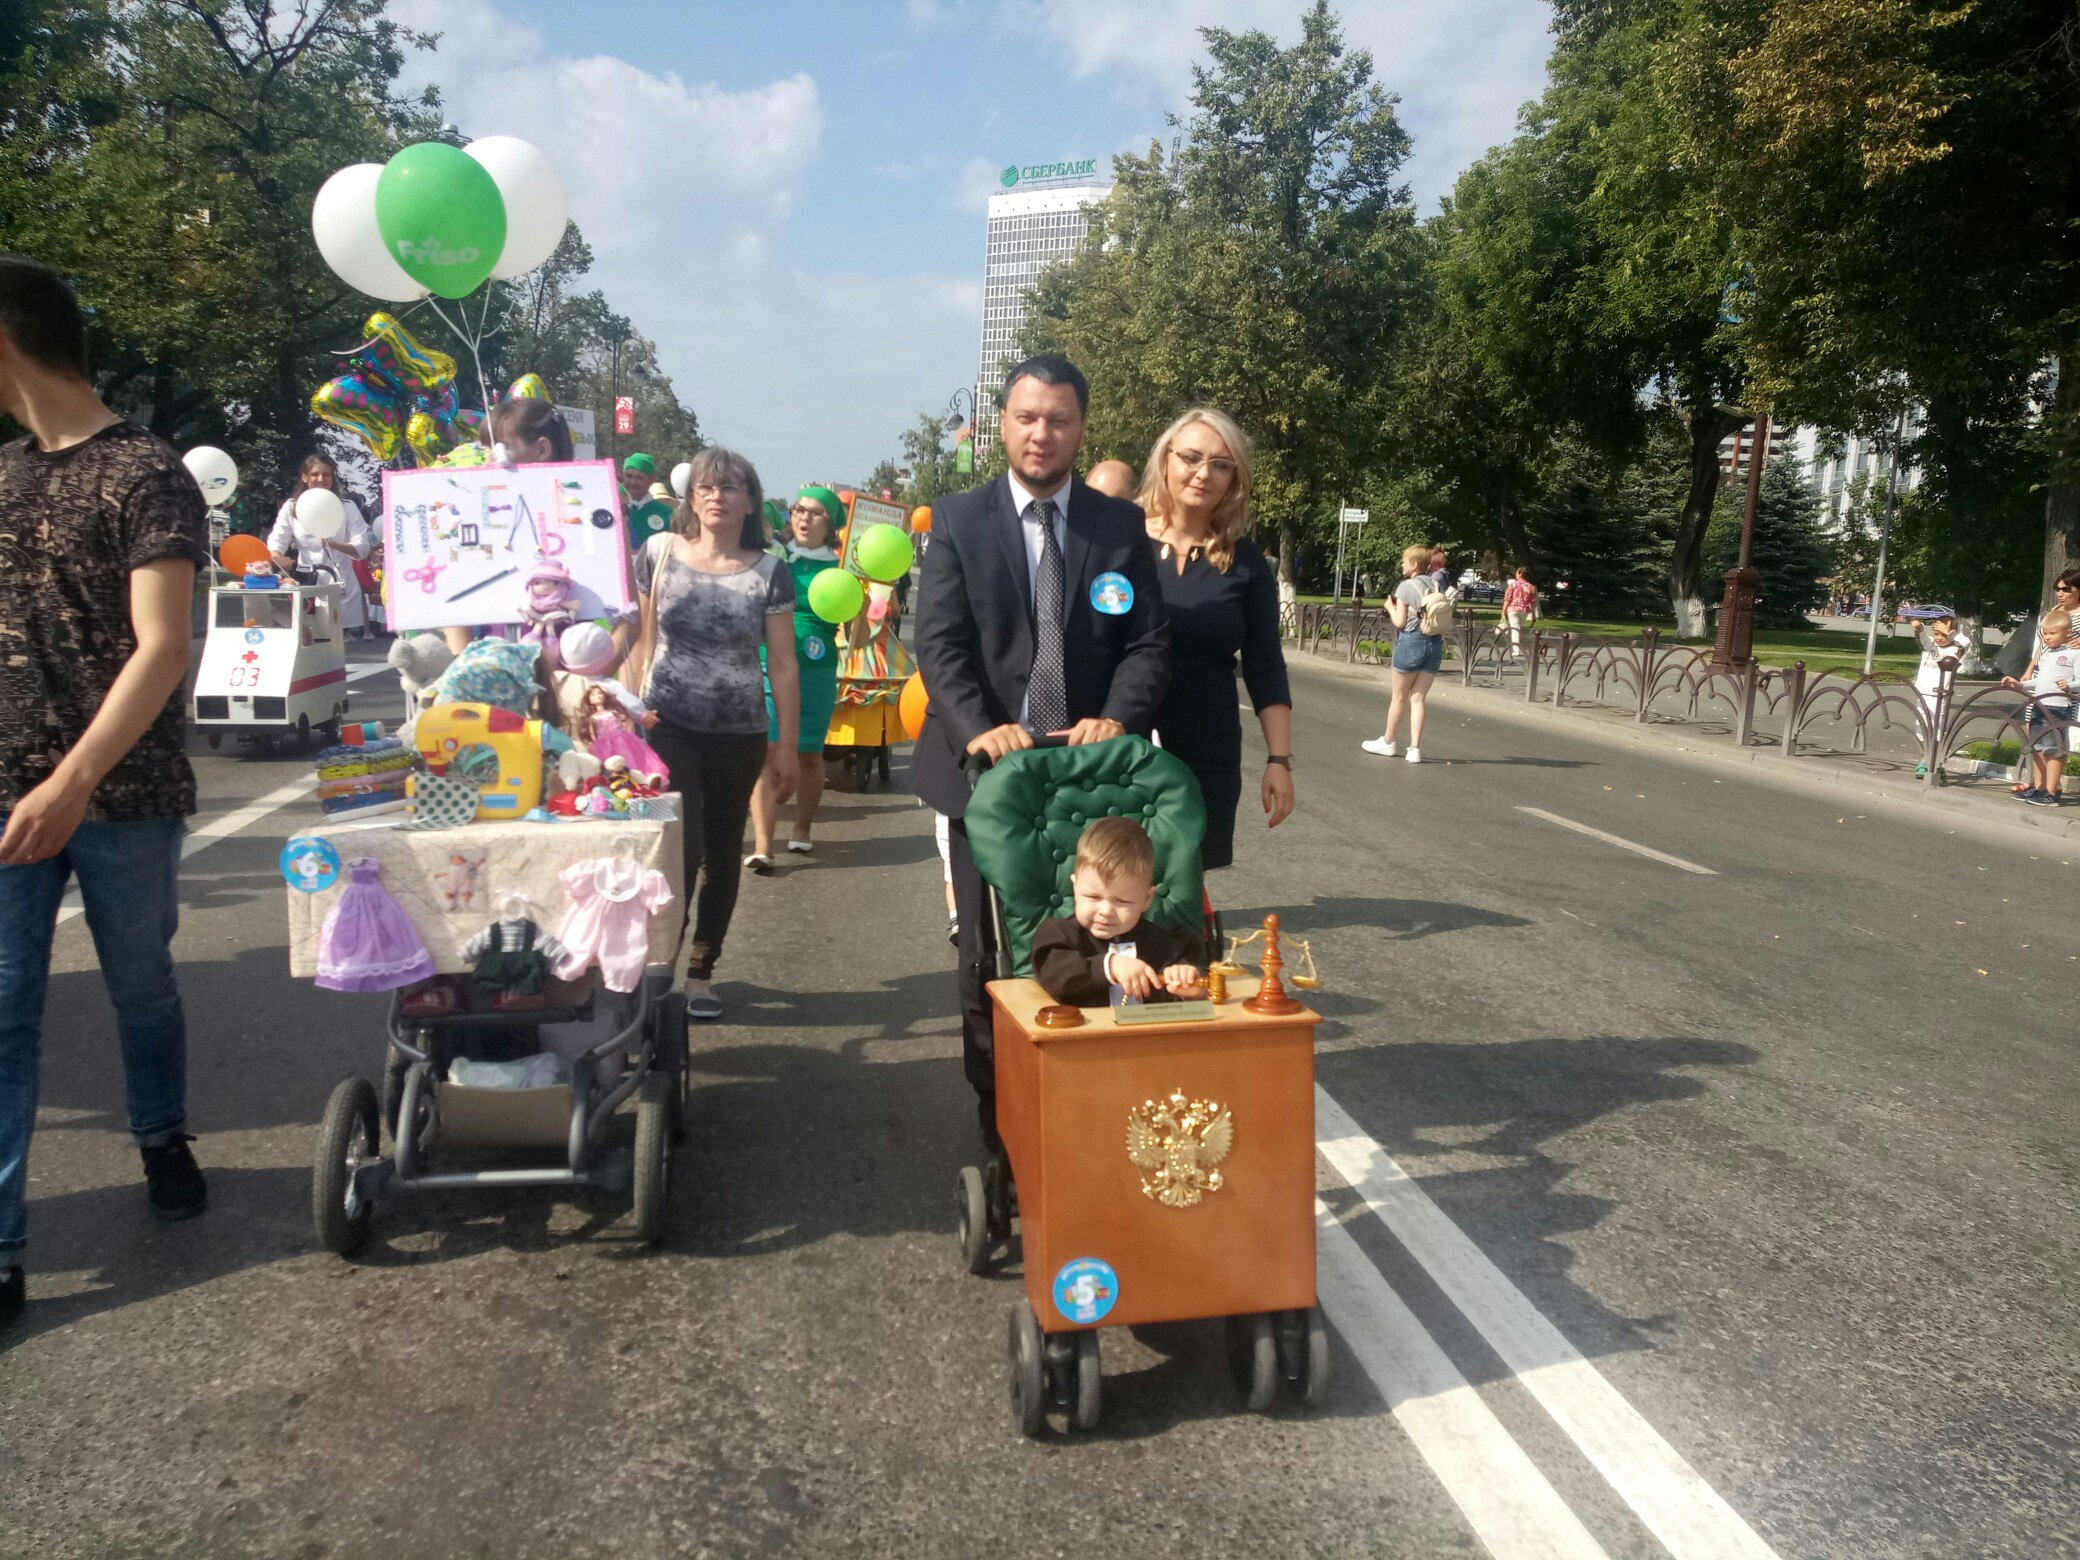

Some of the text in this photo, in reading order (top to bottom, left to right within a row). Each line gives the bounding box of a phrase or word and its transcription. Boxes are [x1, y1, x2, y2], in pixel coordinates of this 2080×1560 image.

[1021, 159, 1097, 179] СБЕРБАНК
[229, 667, 261, 687] 03
[298, 851, 319, 878] 6
[1076, 1274, 1095, 1307] 5
